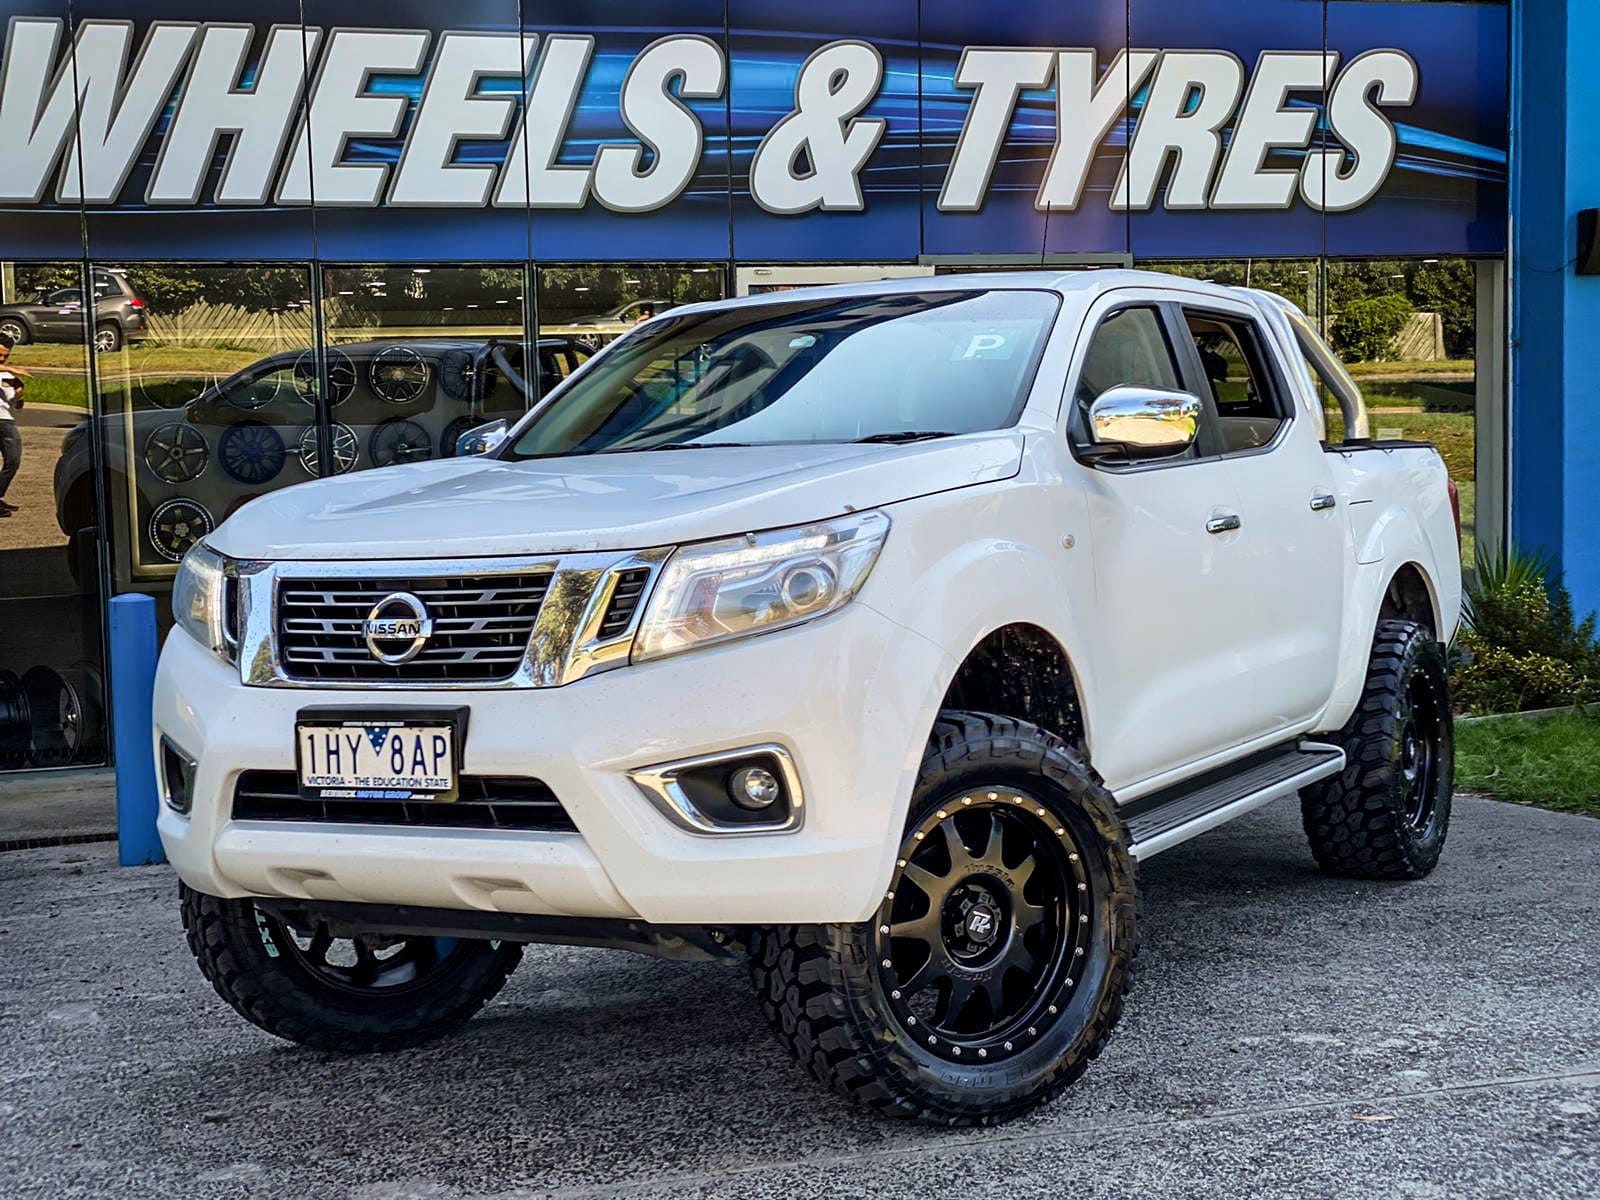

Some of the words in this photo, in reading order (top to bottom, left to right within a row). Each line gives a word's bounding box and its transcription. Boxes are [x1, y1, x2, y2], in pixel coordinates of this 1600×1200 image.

[0, 17, 726, 214] WHEELS
[750, 40, 886, 214] &
[936, 46, 1418, 213] TYRES
[963, 334, 1006, 358] P
[366, 623, 420, 635] NISSAN
[307, 733, 362, 775] 1HY
[391, 734, 447, 776] 8AP
[306, 776, 345, 786] VICTORIA
[354, 777, 370, 787] THE
[373, 777, 422, 788] EDUCATION
[425, 777, 449, 788] STATE
